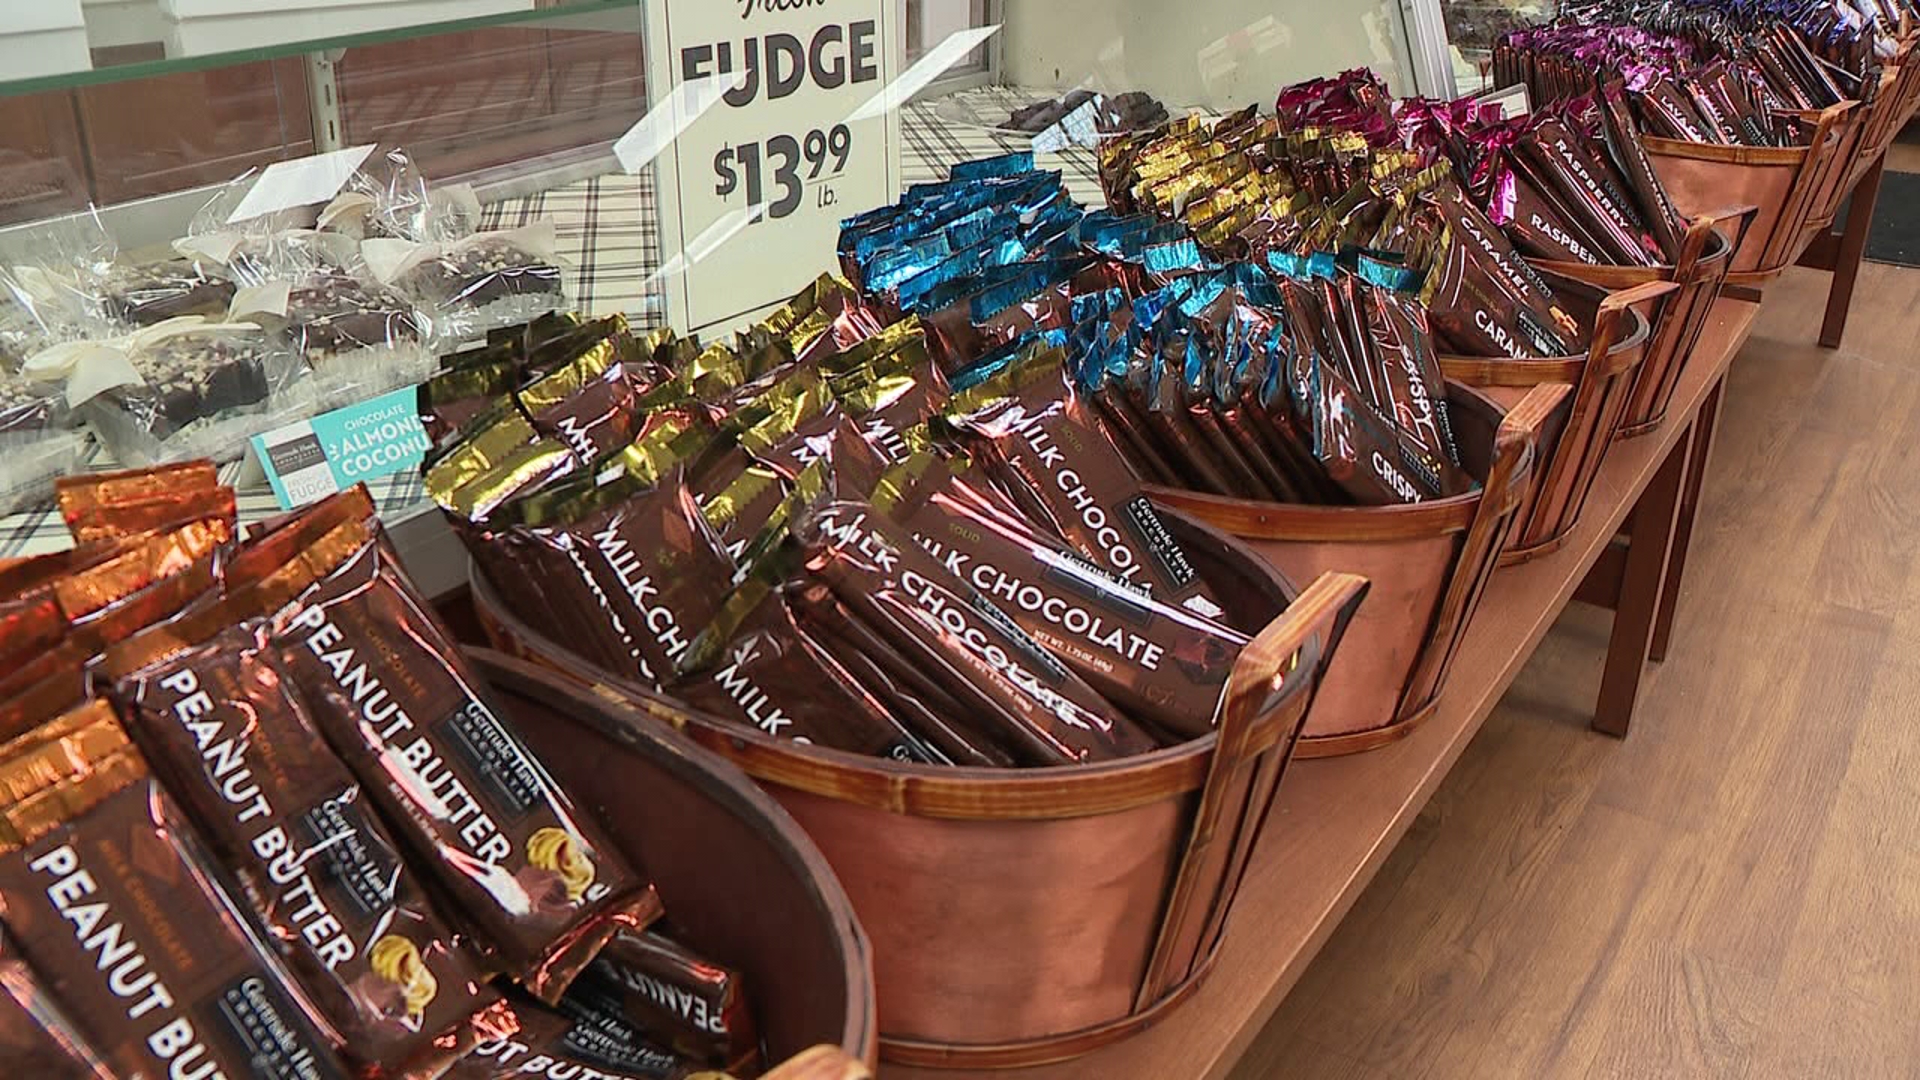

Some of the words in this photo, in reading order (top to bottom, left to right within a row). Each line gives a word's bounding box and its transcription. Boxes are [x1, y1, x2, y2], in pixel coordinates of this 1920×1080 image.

[681, 20, 877, 117] FUDGE
[817, 184, 838, 209] lb.
[1555, 139, 1629, 228] RASPBERRY
[1461, 216, 1531, 297] CARAMEL
[1531, 214, 1600, 265] RASPBER
[1475, 310, 1533, 360] CARAM
[342, 414, 424, 455] ALMOND
[344, 404, 406, 431] CHOCOLATE
[342, 434, 431, 476] COCONU
[1372, 451, 1422, 504] CRISPY
[1010, 408, 1065, 469] MILK
[1056, 469, 1153, 592] CHOCOL
[594, 529, 657, 604] MILK
[819, 512, 898, 573] MILK
[971, 565, 1165, 671] CHOCOLATE
[714, 663, 793, 735] MILK
[300, 604, 415, 740] PEANUT
[401, 737, 512, 868] BUTTER
[159, 668, 272, 823] PEANUT
[252, 826, 356, 972] BUTTER
[29, 845, 175, 1020] PEANUT
[625, 966, 728, 1033] PEANUT
